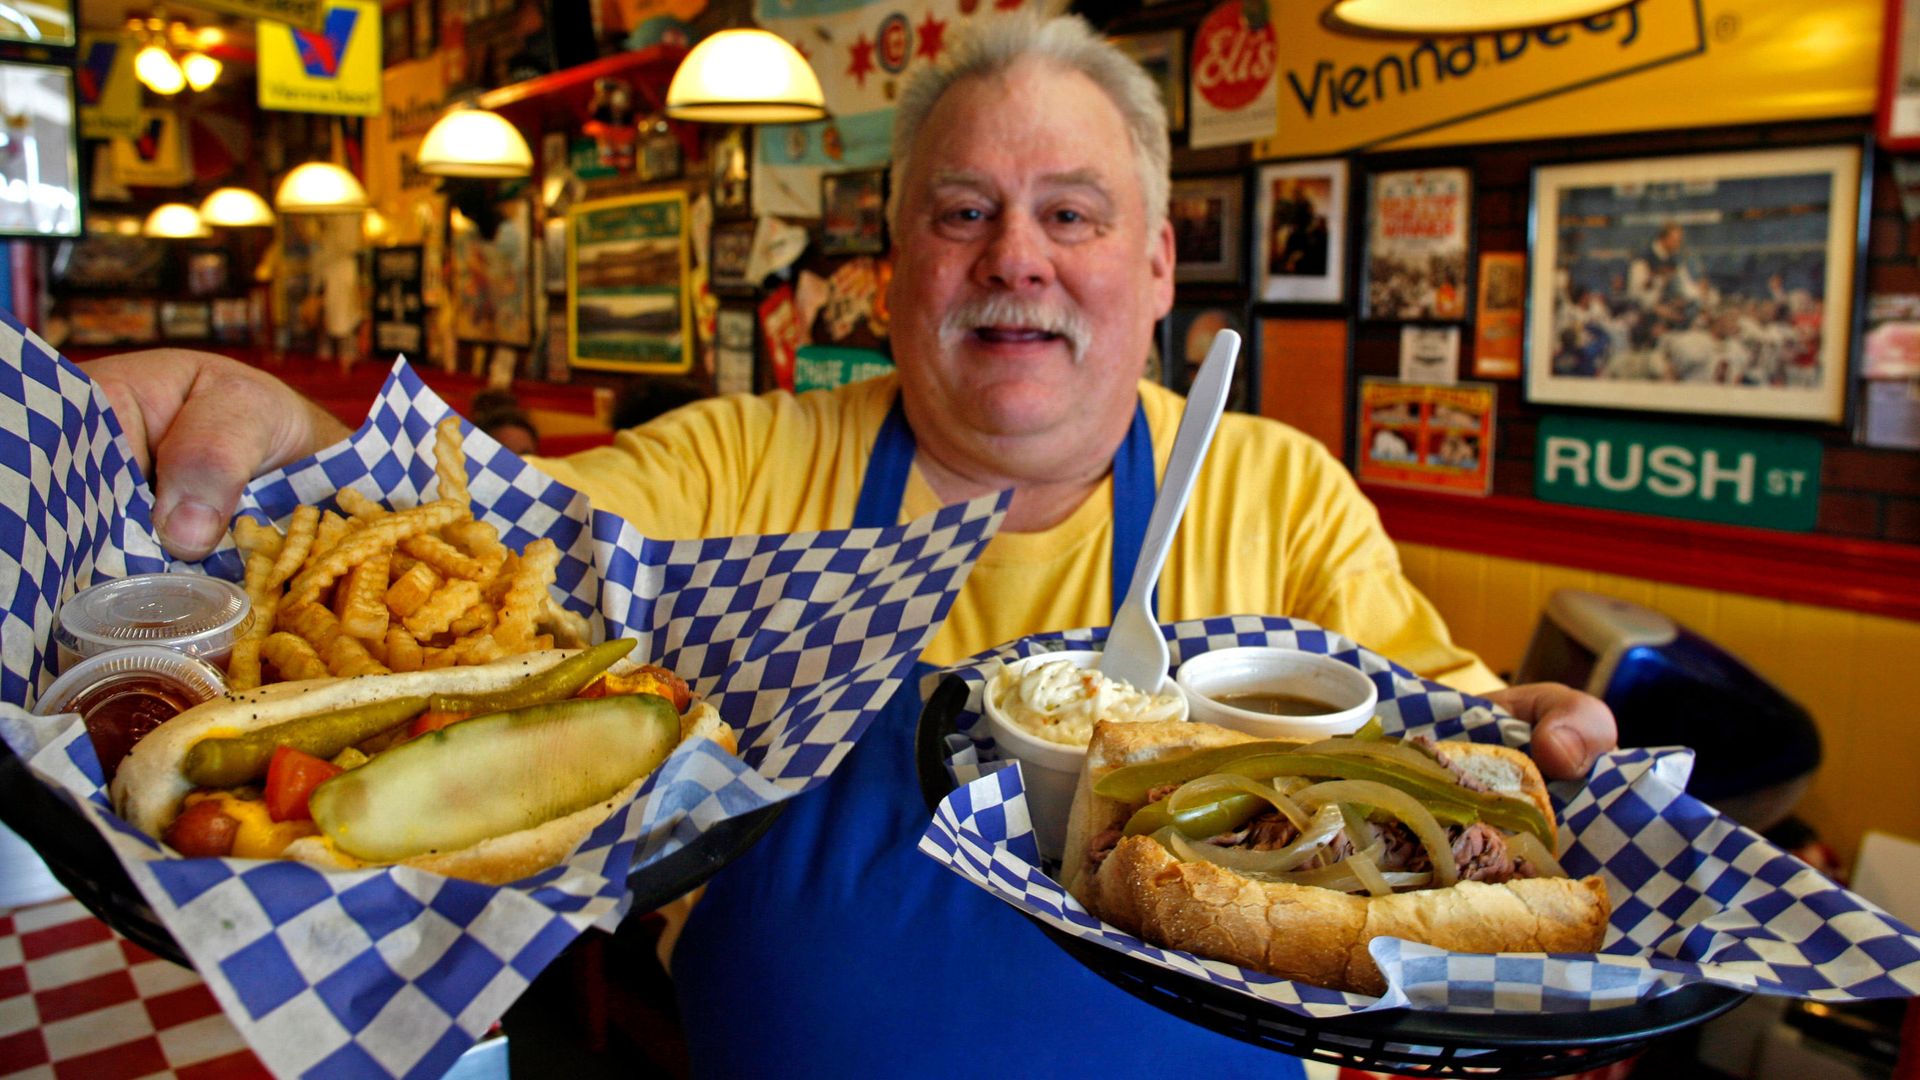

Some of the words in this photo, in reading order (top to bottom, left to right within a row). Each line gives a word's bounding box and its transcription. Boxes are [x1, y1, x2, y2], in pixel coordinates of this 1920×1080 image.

[1286, 36, 1477, 119] Vienna
[1543, 435, 1757, 505] RUSH
[1766, 467, 1808, 497] ST
